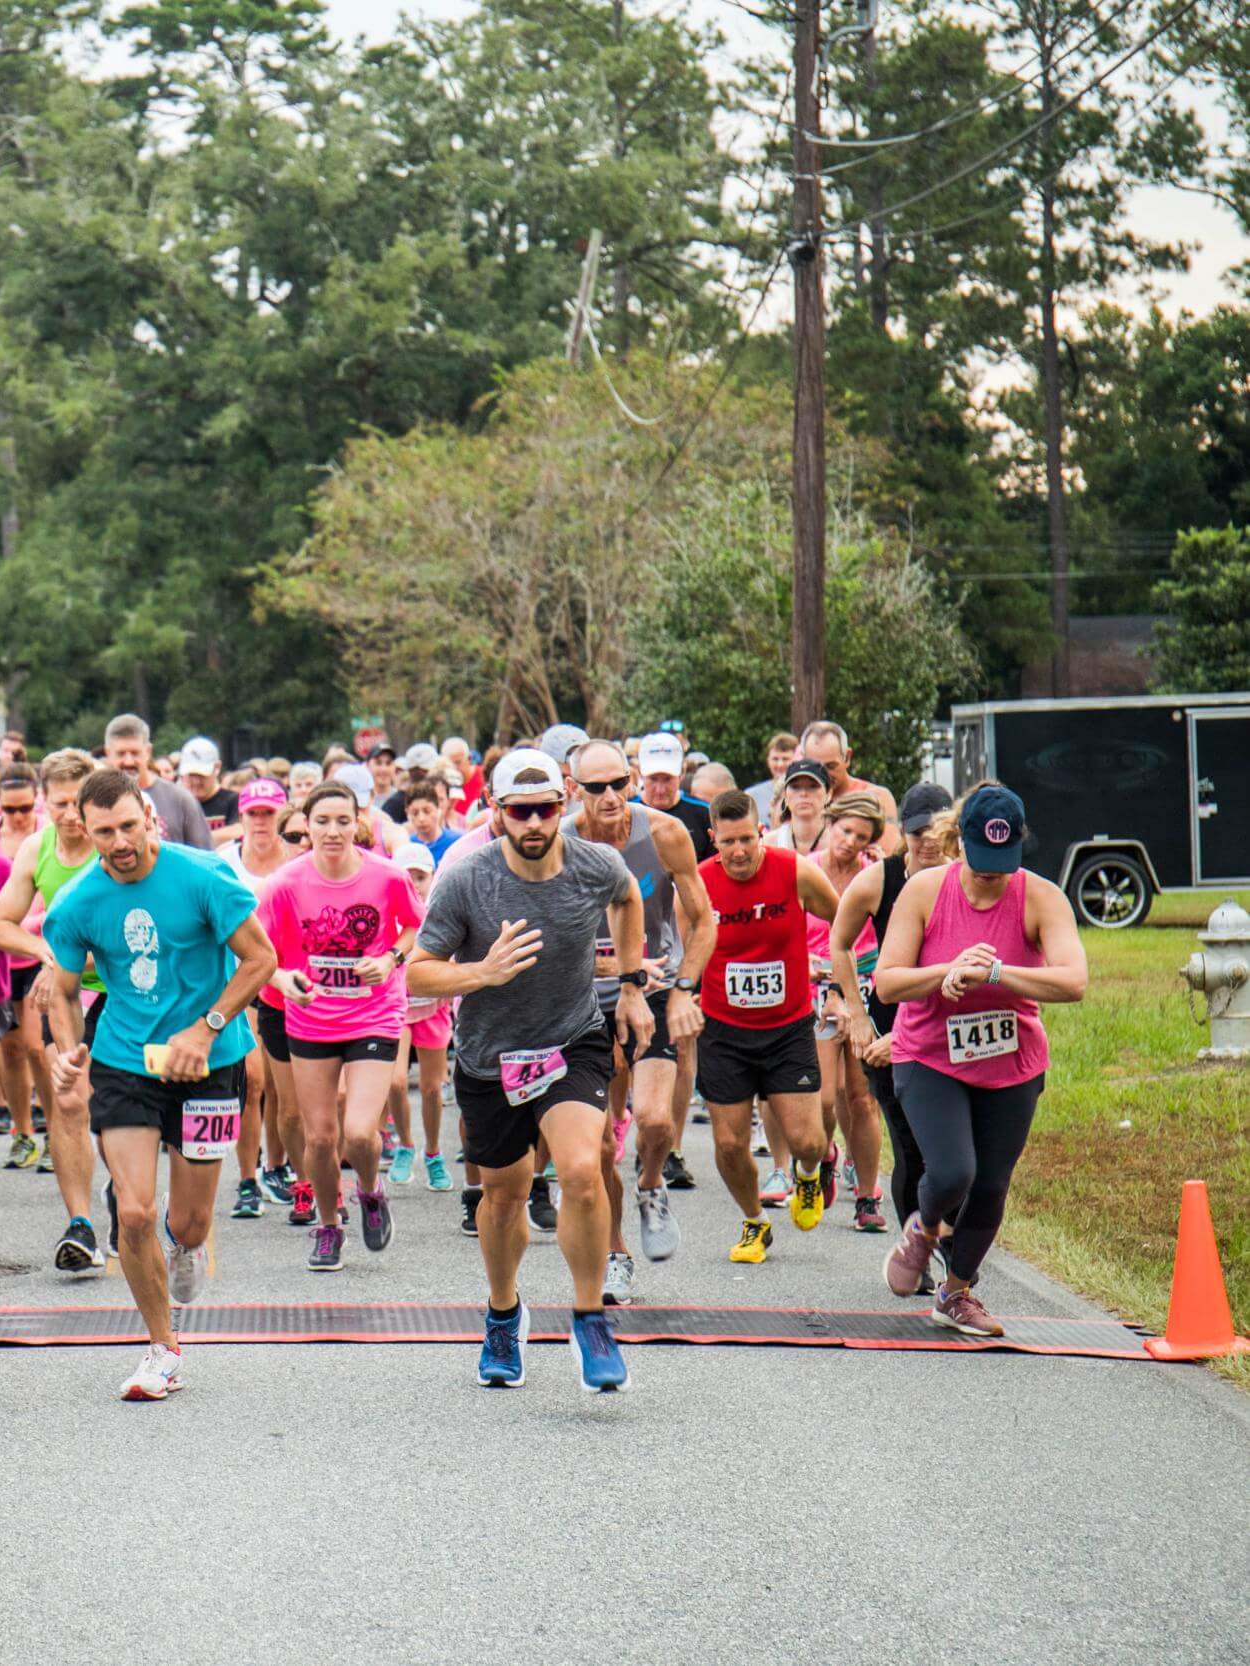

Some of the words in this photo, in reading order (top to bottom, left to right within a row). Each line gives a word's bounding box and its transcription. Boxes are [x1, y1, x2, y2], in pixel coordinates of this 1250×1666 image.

[318, 967, 361, 988] 205
[728, 972, 783, 996] 1453
[951, 1019, 1015, 1050] 1418
[193, 1115, 235, 1143] 204
